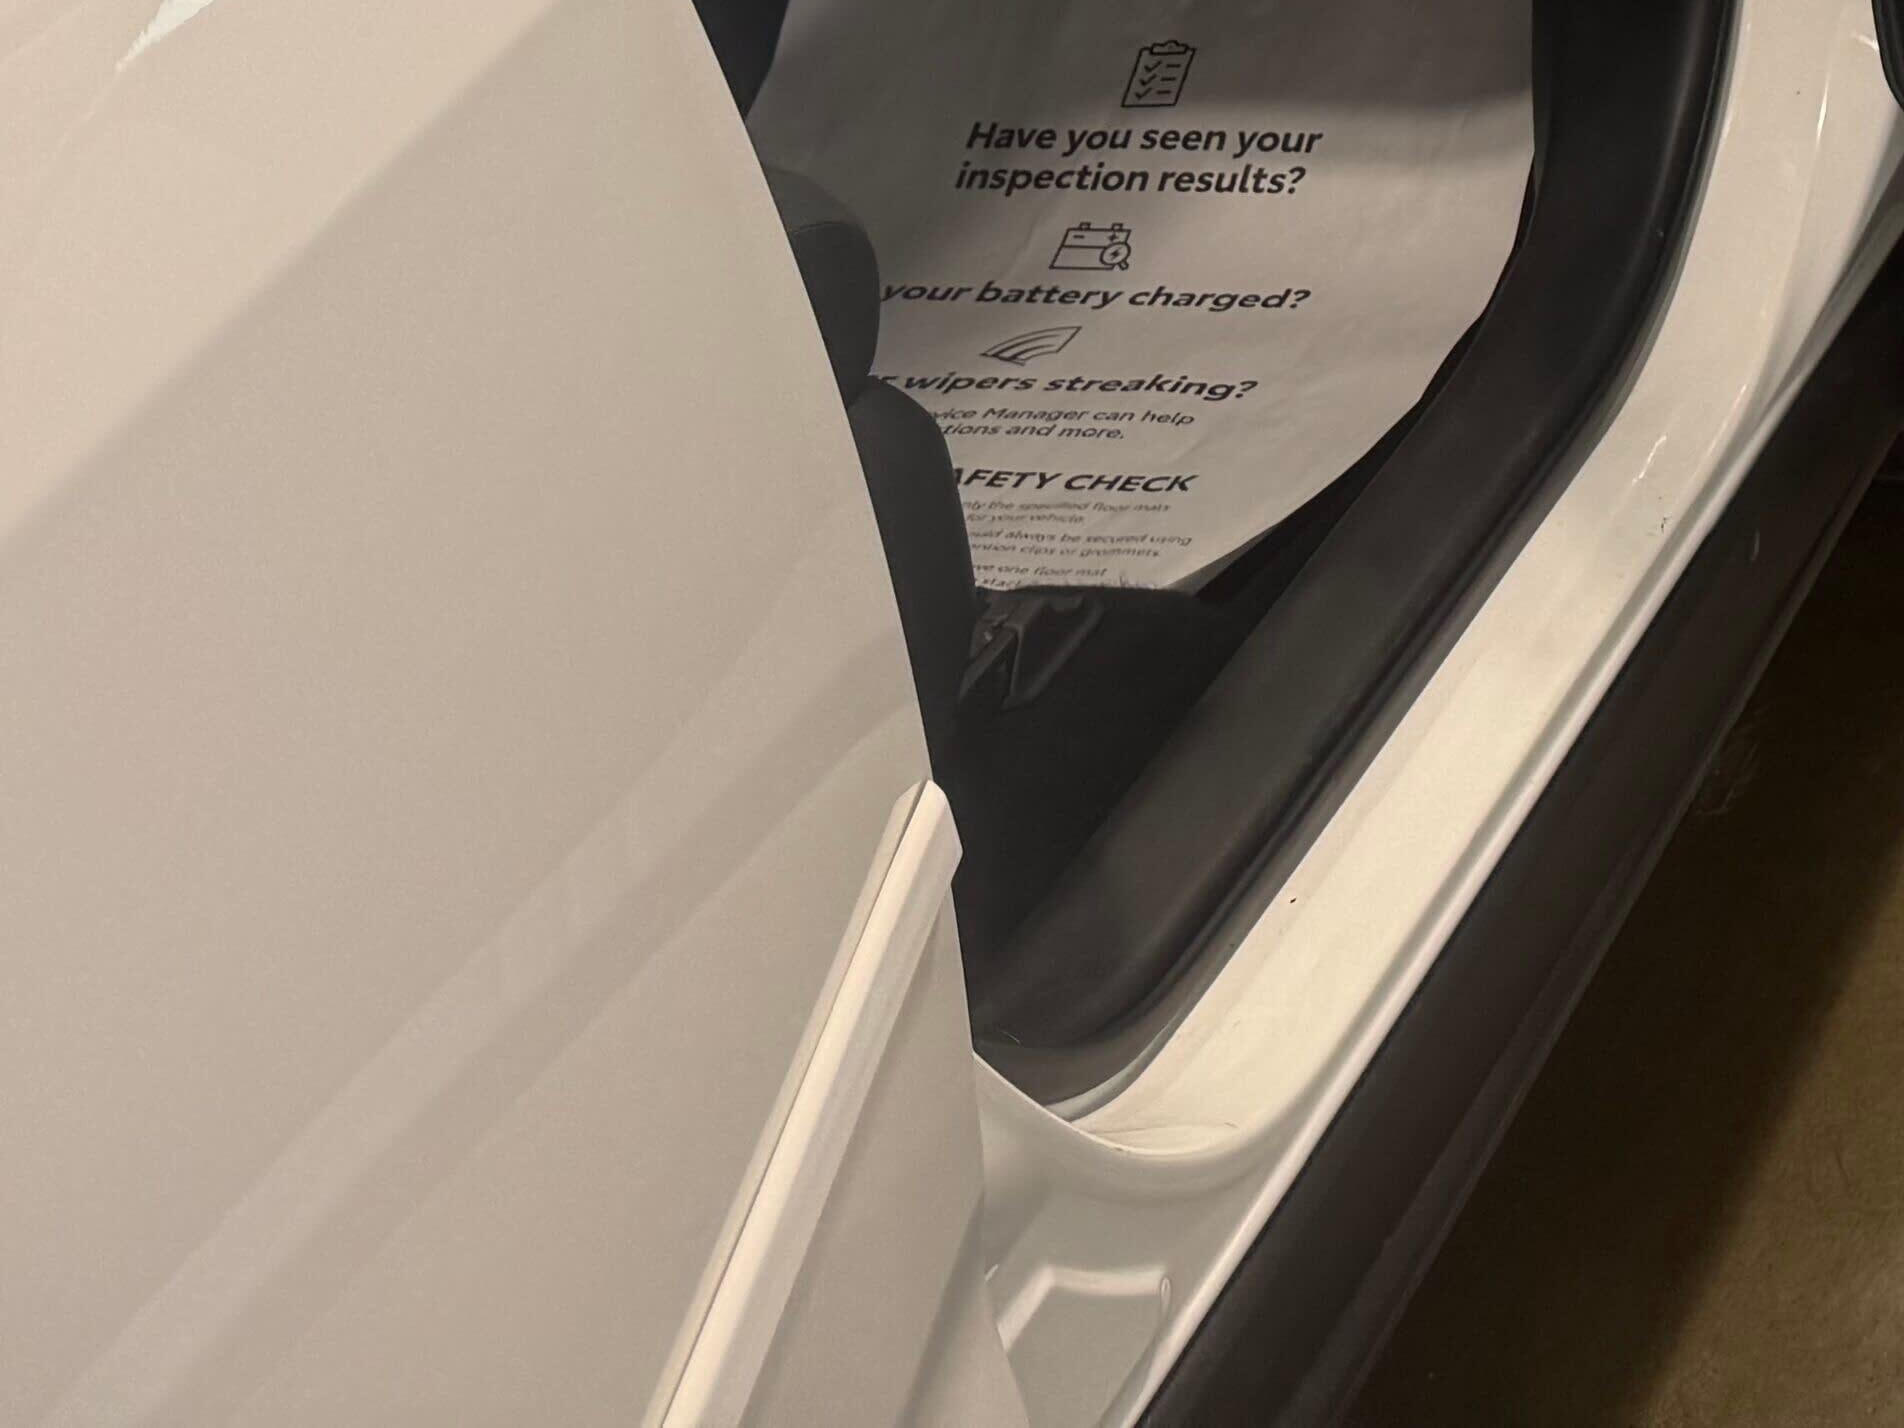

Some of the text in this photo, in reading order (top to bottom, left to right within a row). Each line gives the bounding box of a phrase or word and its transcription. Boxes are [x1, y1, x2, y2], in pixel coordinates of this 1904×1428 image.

[964, 121, 1324, 159] Have you seen your
[954, 161, 1307, 197] inspection results?
[880, 280, 1311, 312] your battery charged?
[904, 370, 1259, 401] wipers streaking?
[981, 407, 1089, 423] Manager
[1092, 410, 1135, 422] can
[1139, 409, 1196, 427] help
[1004, 423, 1057, 437] and
[1057, 427, 1125, 440] more.
[1064, 473, 1200, 493] CHECK
